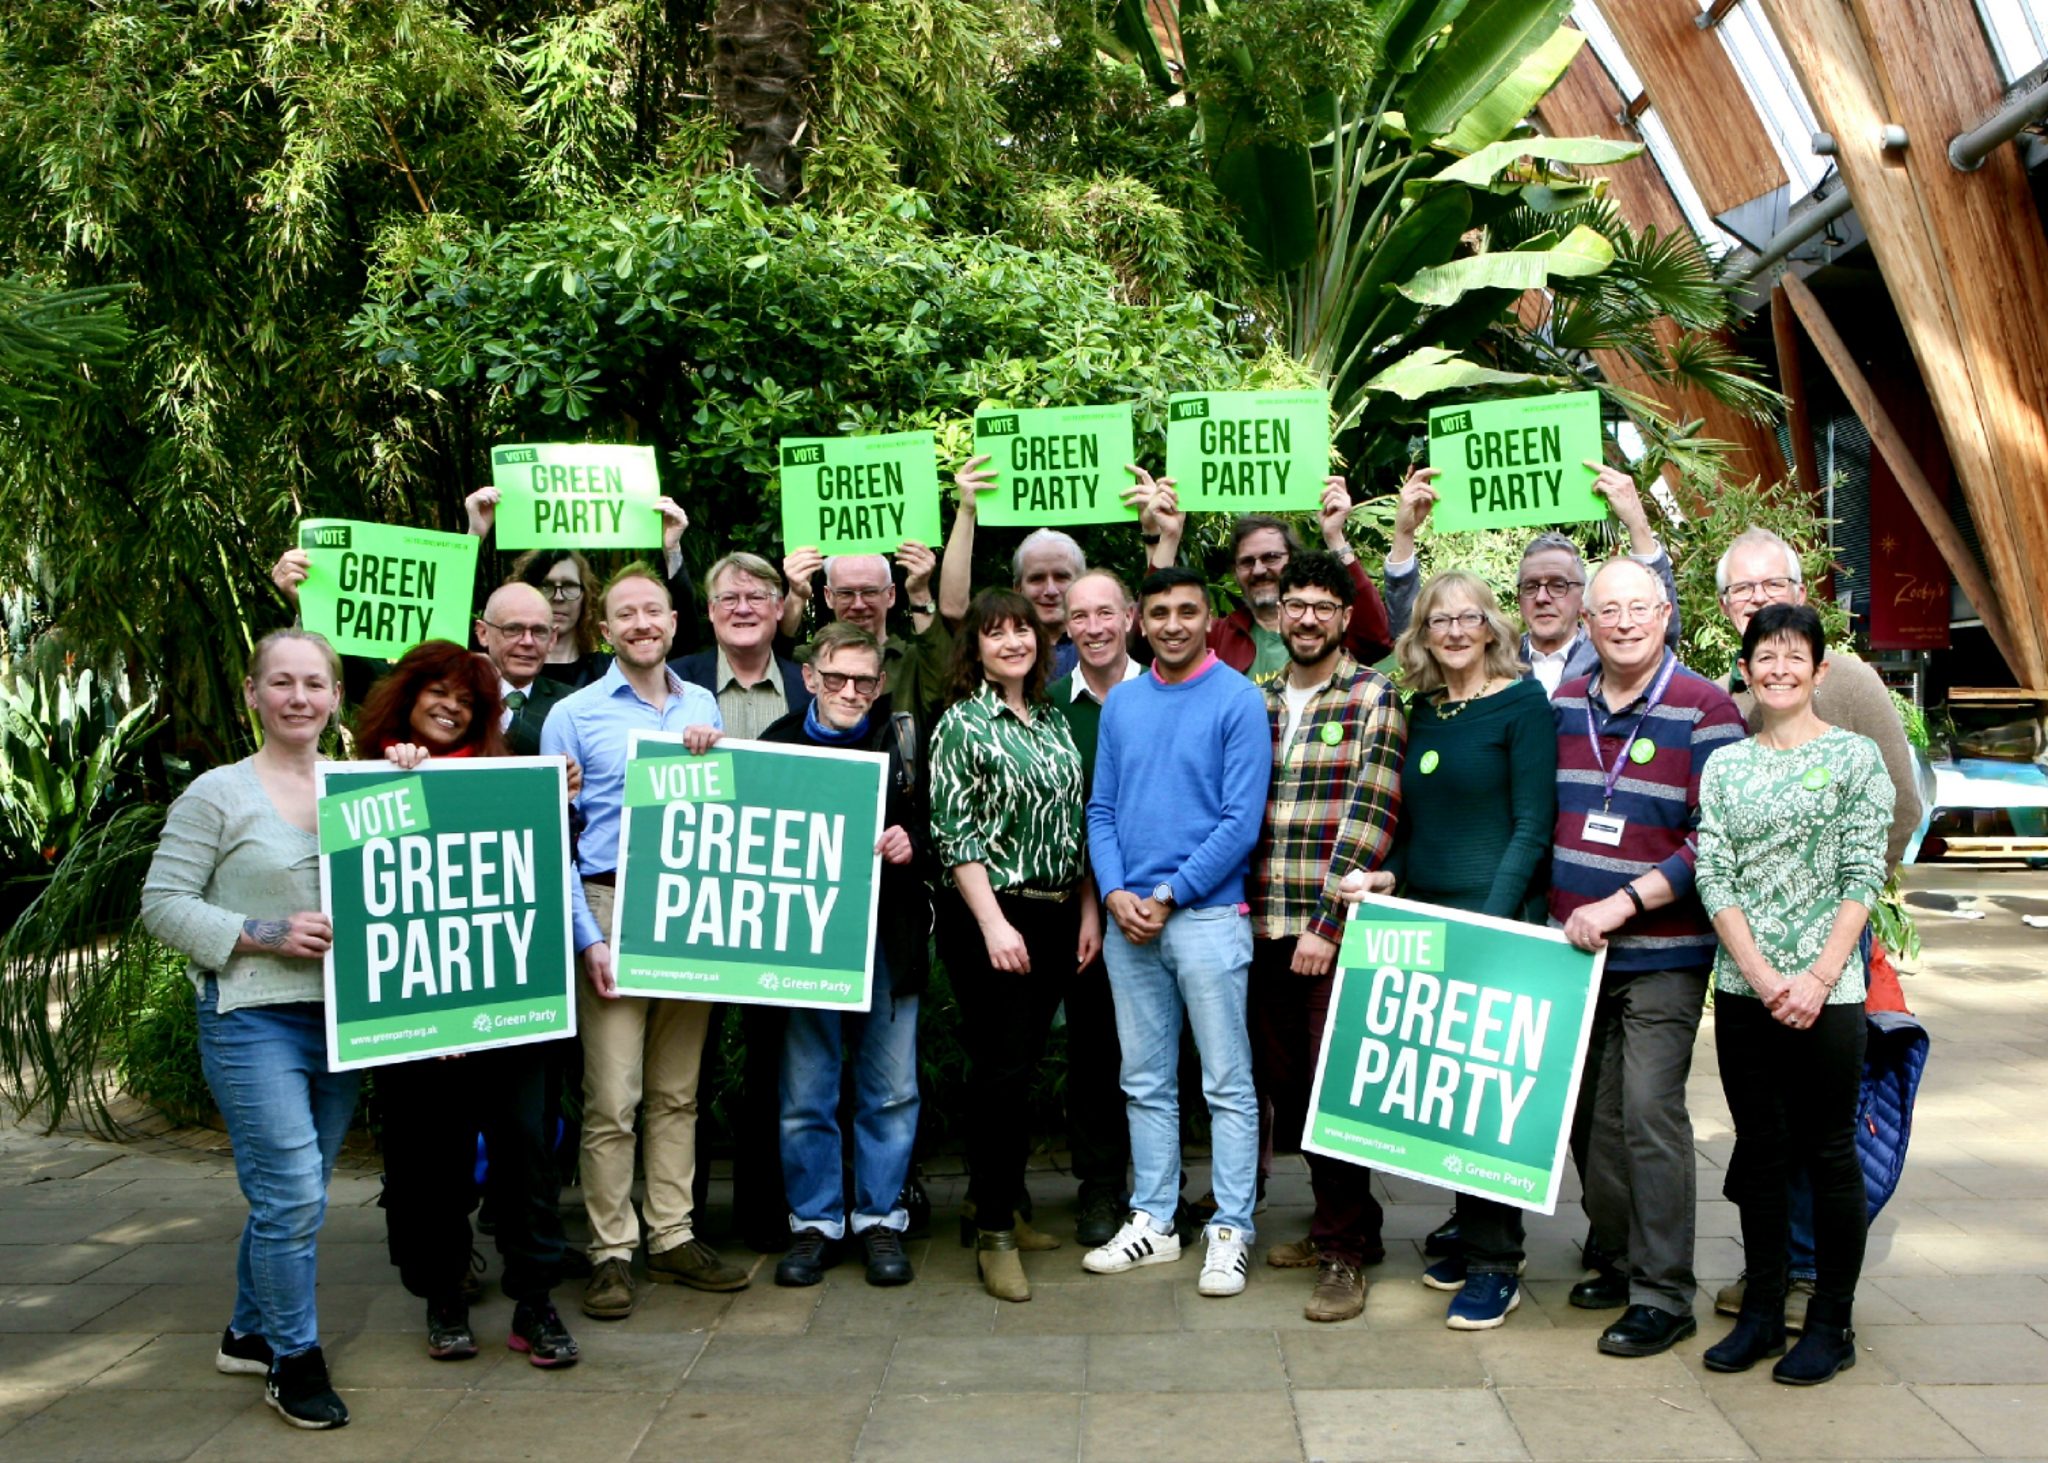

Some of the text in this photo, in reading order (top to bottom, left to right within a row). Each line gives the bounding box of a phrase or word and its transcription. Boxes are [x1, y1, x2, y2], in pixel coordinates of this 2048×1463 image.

[987, 418, 1014, 433] VOTE
[1179, 401, 1204, 417] VOTE
[1441, 414, 1467, 433] VOTE
[1011, 434, 1098, 470] GREEN
[1201, 419, 1290, 454] GREEN
[1465, 426, 1561, 471] GREEN
[505, 449, 532, 461] VOTE
[792, 449, 819, 463] VOTE
[532, 464, 623, 493] GREEN
[817, 461, 904, 500] GREEN
[1013, 474, 1099, 510] PARTY
[1202, 460, 1291, 496] PARTY
[1470, 470, 1563, 513] PARTY
[535, 500, 624, 533] PARTY
[819, 502, 905, 541] PARTY
[315, 530, 346, 546] VOTE
[340, 552, 436, 599] GREEN
[337, 598, 432, 642] PARTY
[648, 762, 721, 800] VOTE
[340, 788, 415, 841] VOTE
[660, 800, 845, 882] GREEN
[362, 829, 536, 916] GREEN
[654, 873, 839, 954] PARTY
[365, 909, 536, 1002] PARTY
[1365, 928, 1431, 965] VOTE
[782, 977, 851, 995] Green Party
[494, 1008, 556, 1027] Green Party
[1365, 966, 1551, 1072] GREEN
[1350, 1037, 1535, 1146] PARTY
[1465, 1163, 1500, 1181] Green
[1504, 1170, 1535, 1192] Party
